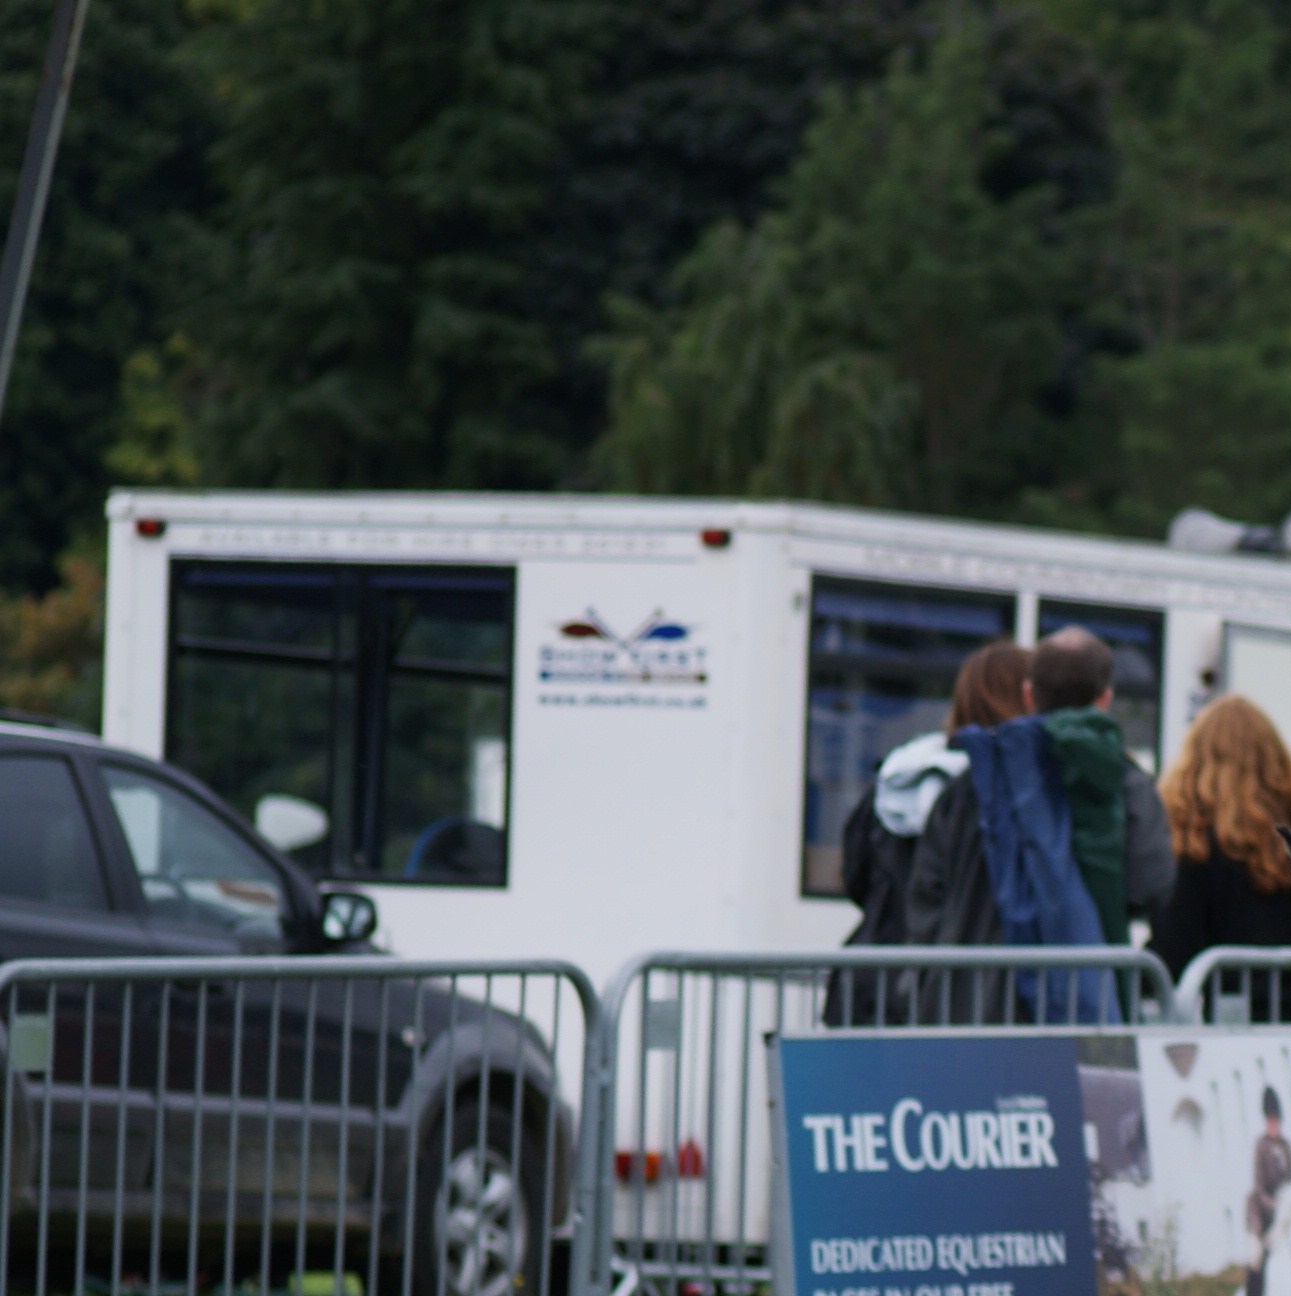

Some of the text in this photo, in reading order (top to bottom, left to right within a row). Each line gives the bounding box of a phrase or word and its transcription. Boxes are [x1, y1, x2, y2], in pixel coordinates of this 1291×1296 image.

[803, 1098, 1058, 1173] THE COURIER
[810, 1231, 1067, 1276] DEDICATED EQUESTRIAN
